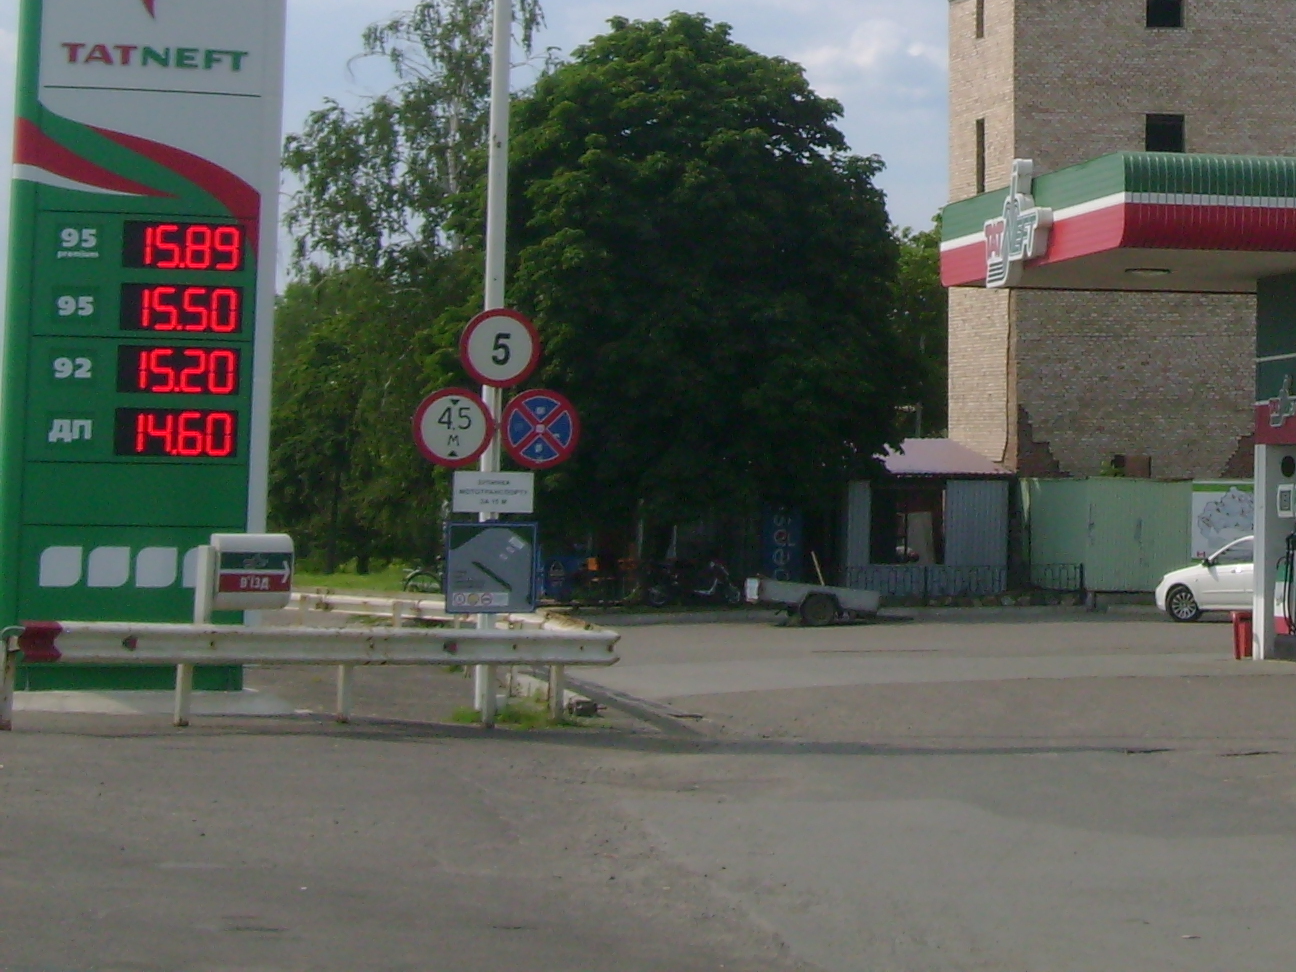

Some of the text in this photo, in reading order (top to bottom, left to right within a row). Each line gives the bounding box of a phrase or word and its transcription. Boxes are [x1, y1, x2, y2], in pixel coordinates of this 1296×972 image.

[61, 42, 249, 72] TATNEFT
[60, 228, 98, 248] 95
[143, 224, 241, 270] 15.89
[57, 295, 95, 316] 95
[140, 285, 238, 333] 15.50
[491, 332, 512, 366] 5
[53, 357, 92, 378] 92
[138, 348, 236, 395] 15.20
[48, 418, 93, 443] ДП
[135, 411, 233, 457] 14.60
